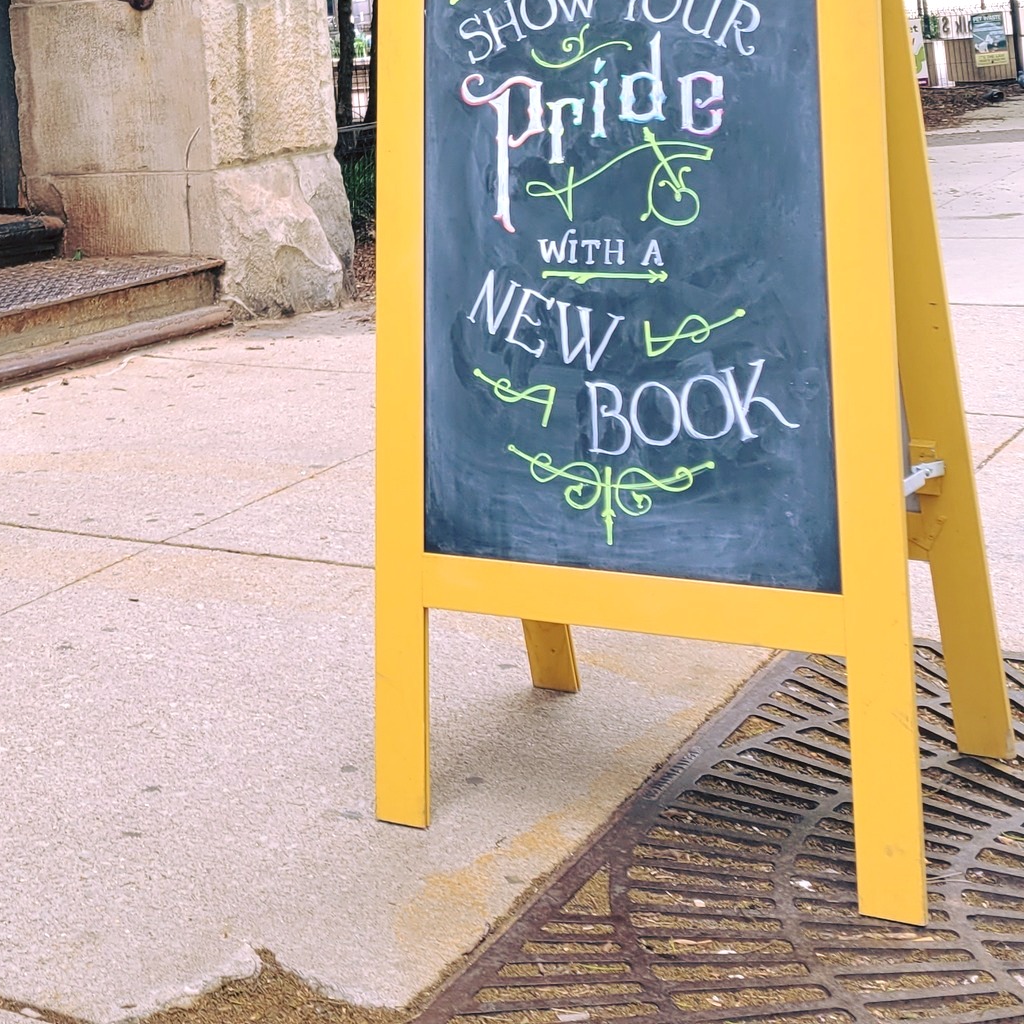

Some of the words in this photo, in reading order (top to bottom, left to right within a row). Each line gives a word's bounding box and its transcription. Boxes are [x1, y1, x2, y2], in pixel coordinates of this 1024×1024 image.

[461, 31, 725, 233] Pride
[538, 229, 626, 266] WITH
[641, 239, 664, 266] A
[466, 269, 626, 372] NEW
[584, 358, 800, 456] BOOK
